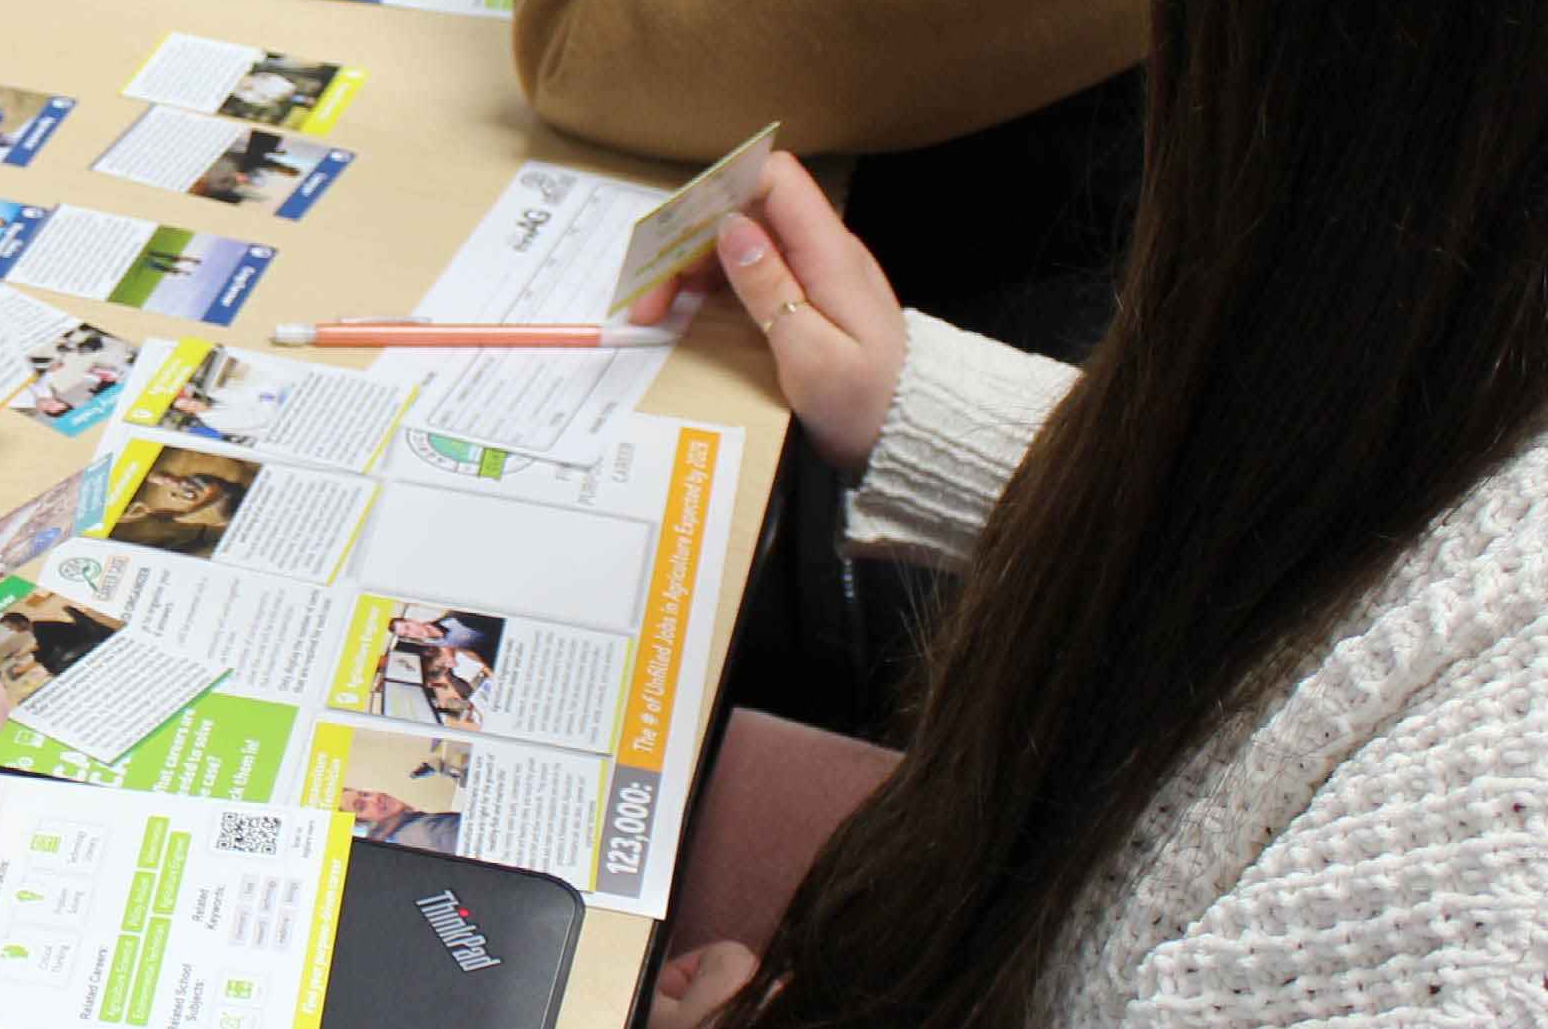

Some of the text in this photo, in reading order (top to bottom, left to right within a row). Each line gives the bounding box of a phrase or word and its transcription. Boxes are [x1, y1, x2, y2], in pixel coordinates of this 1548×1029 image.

[683, 465, 710, 484] by
[672, 480, 707, 536] Expected
[660, 534, 699, 602] Agriculture
[658, 599, 681, 615] in
[652, 614, 678, 645] Jobs
[641, 643, 673, 697] Unfilled
[638, 694, 664, 712] of
[163, 725, 189, 768] careers
[177, 706, 196, 726] are
[189, 717, 214, 748] solve
[630, 726, 658, 754] The
[186, 747, 204, 761] to
[229, 753, 256, 786] them
[603, 780, 658, 878] 123,000:
[325, 856, 341, 889] career
[190, 887, 209, 922] Related
[204, 883, 227, 931] Keywords:
[414, 889, 503, 972] ThinkPad
[79, 945, 109, 1020] Related Careers:
[172, 962, 192, 996] School
[308, 966, 326, 990] your
[185, 977, 206, 1022] Subjects:
[301, 989, 319, 1014] Find
